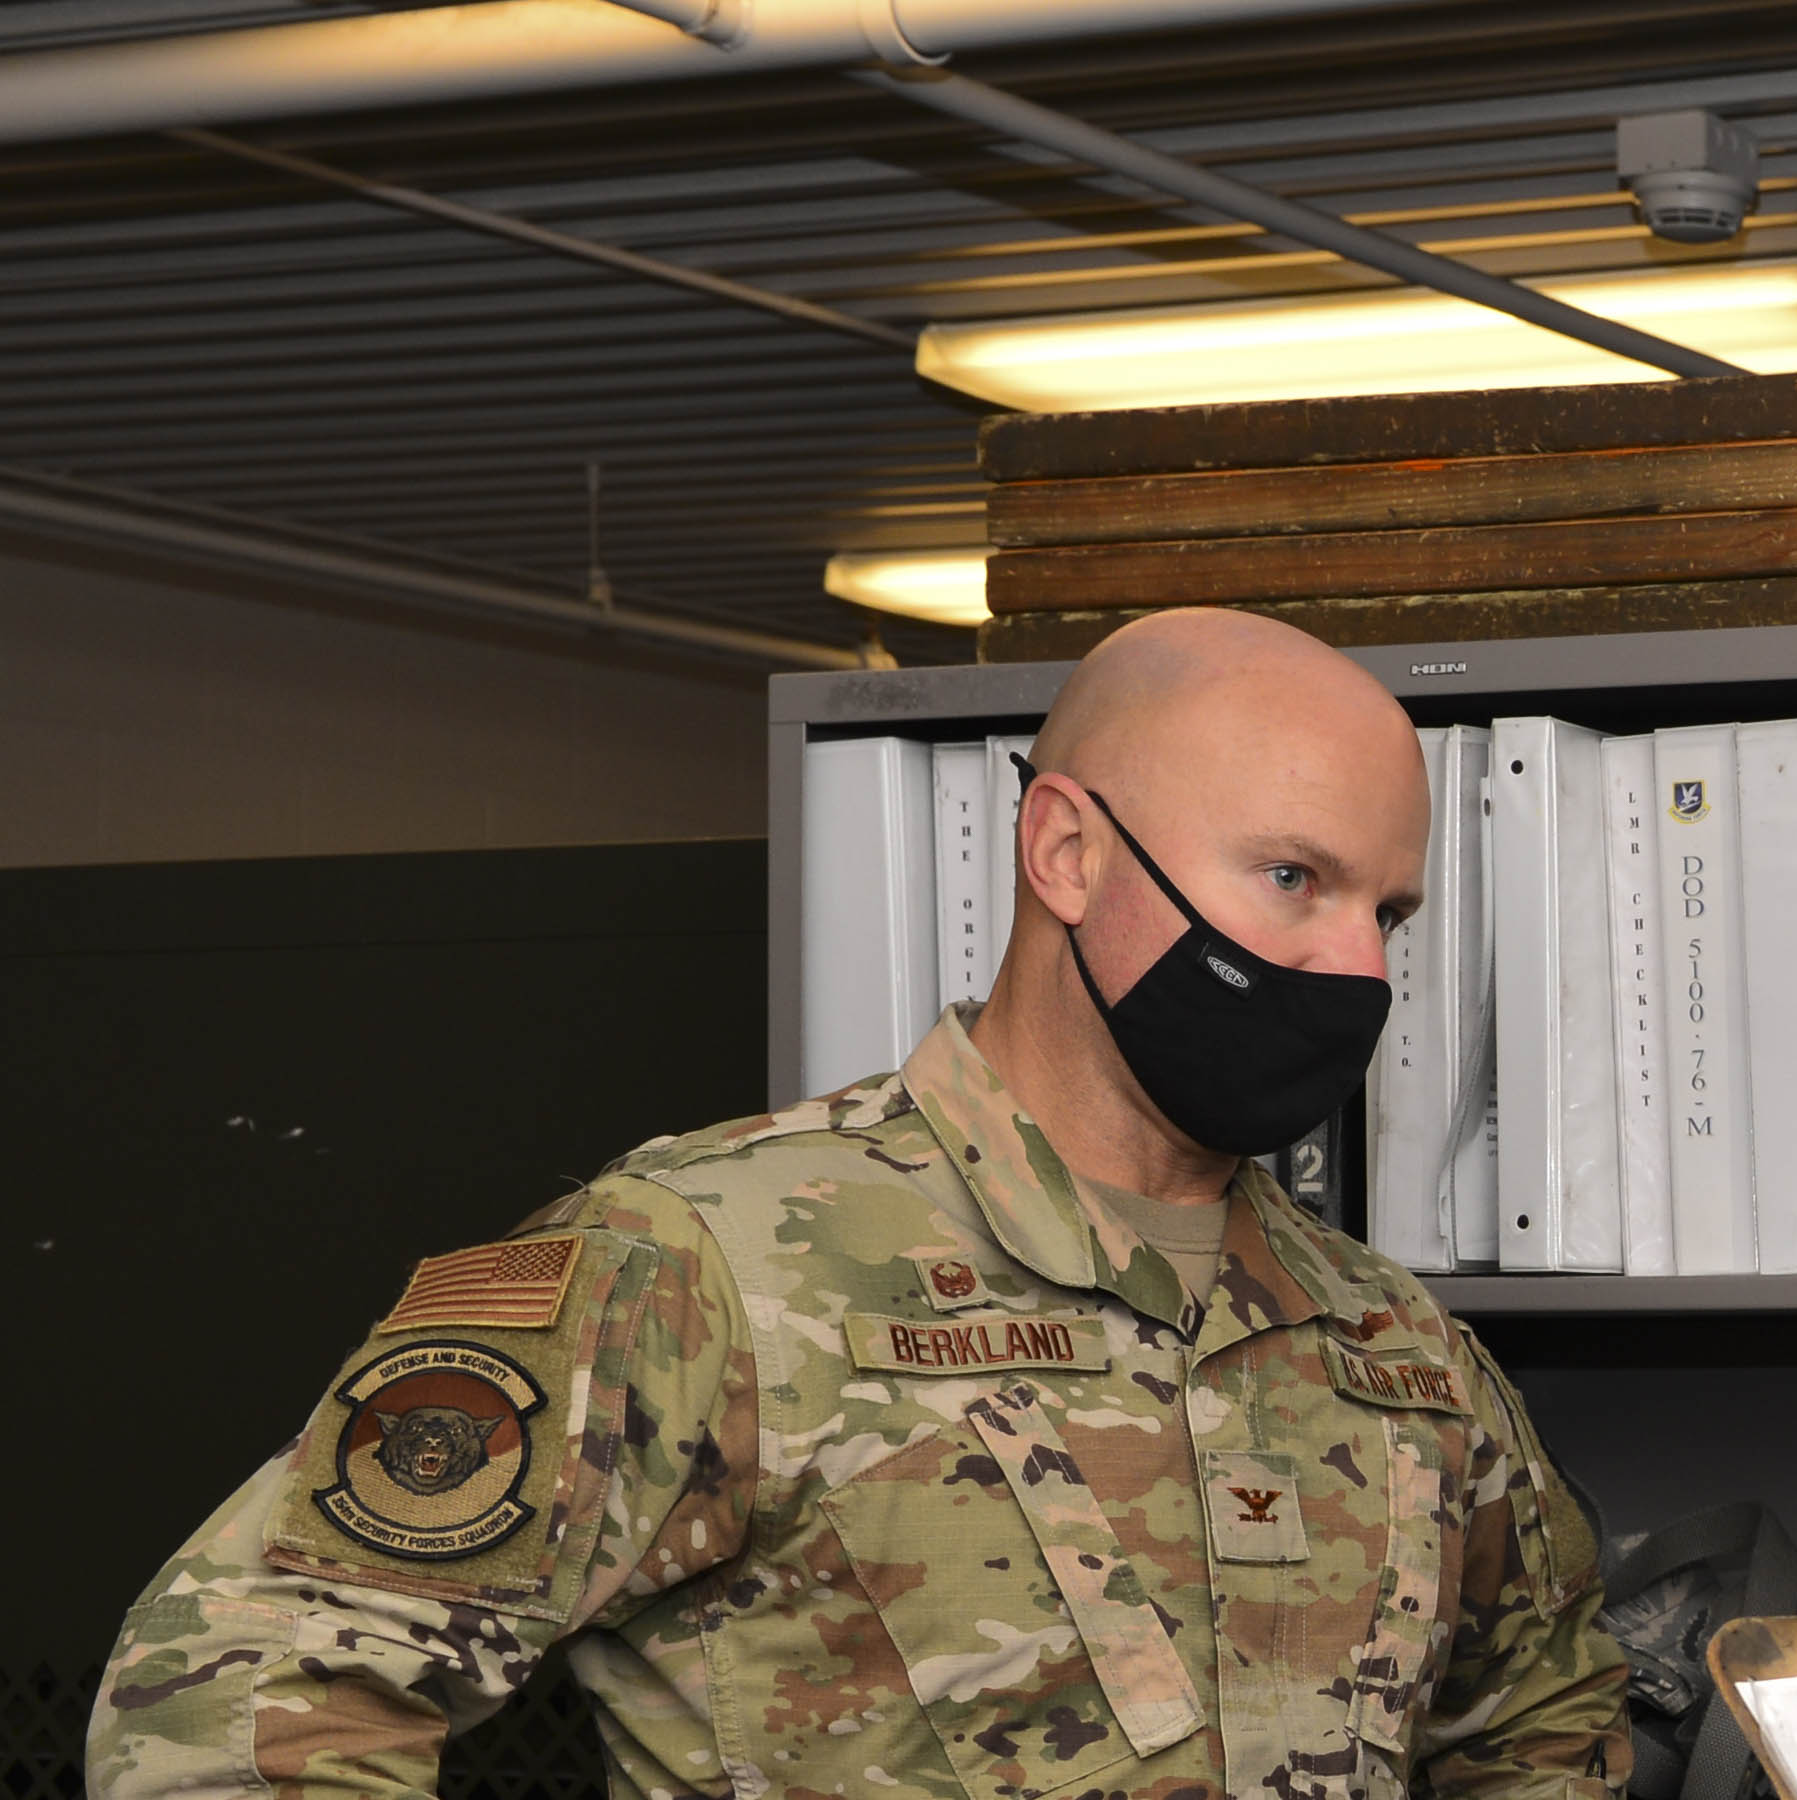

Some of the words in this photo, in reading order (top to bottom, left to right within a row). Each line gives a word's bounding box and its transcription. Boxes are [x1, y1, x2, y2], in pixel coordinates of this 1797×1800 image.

[1411, 662, 1467, 675] HON
[959, 801, 972, 862] THE
[1628, 791, 1641, 855] LMR
[1681, 855, 1705, 919] DOD
[963, 898, 975, 1002] ORGI
[1208, 956, 1249, 988] KEEN
[1633, 892, 1651, 1108] CHECKLIST
[1296, 1144, 1324, 1193] 2
[379, 1352, 430, 1379] DEFENSE
[432, 1352, 457, 1364] AND
[457, 1353, 511, 1382] SECURITY
[887, 1321, 1076, 1367] BERKLAND
[1362, 1360, 1401, 1400] AIR
[1395, 1364, 1461, 1408] FORCE
[353, 1517, 406, 1546] SECURITY
[407, 1535, 457, 1549] FORCES
[457, 1507, 515, 1546] SQUADRON
